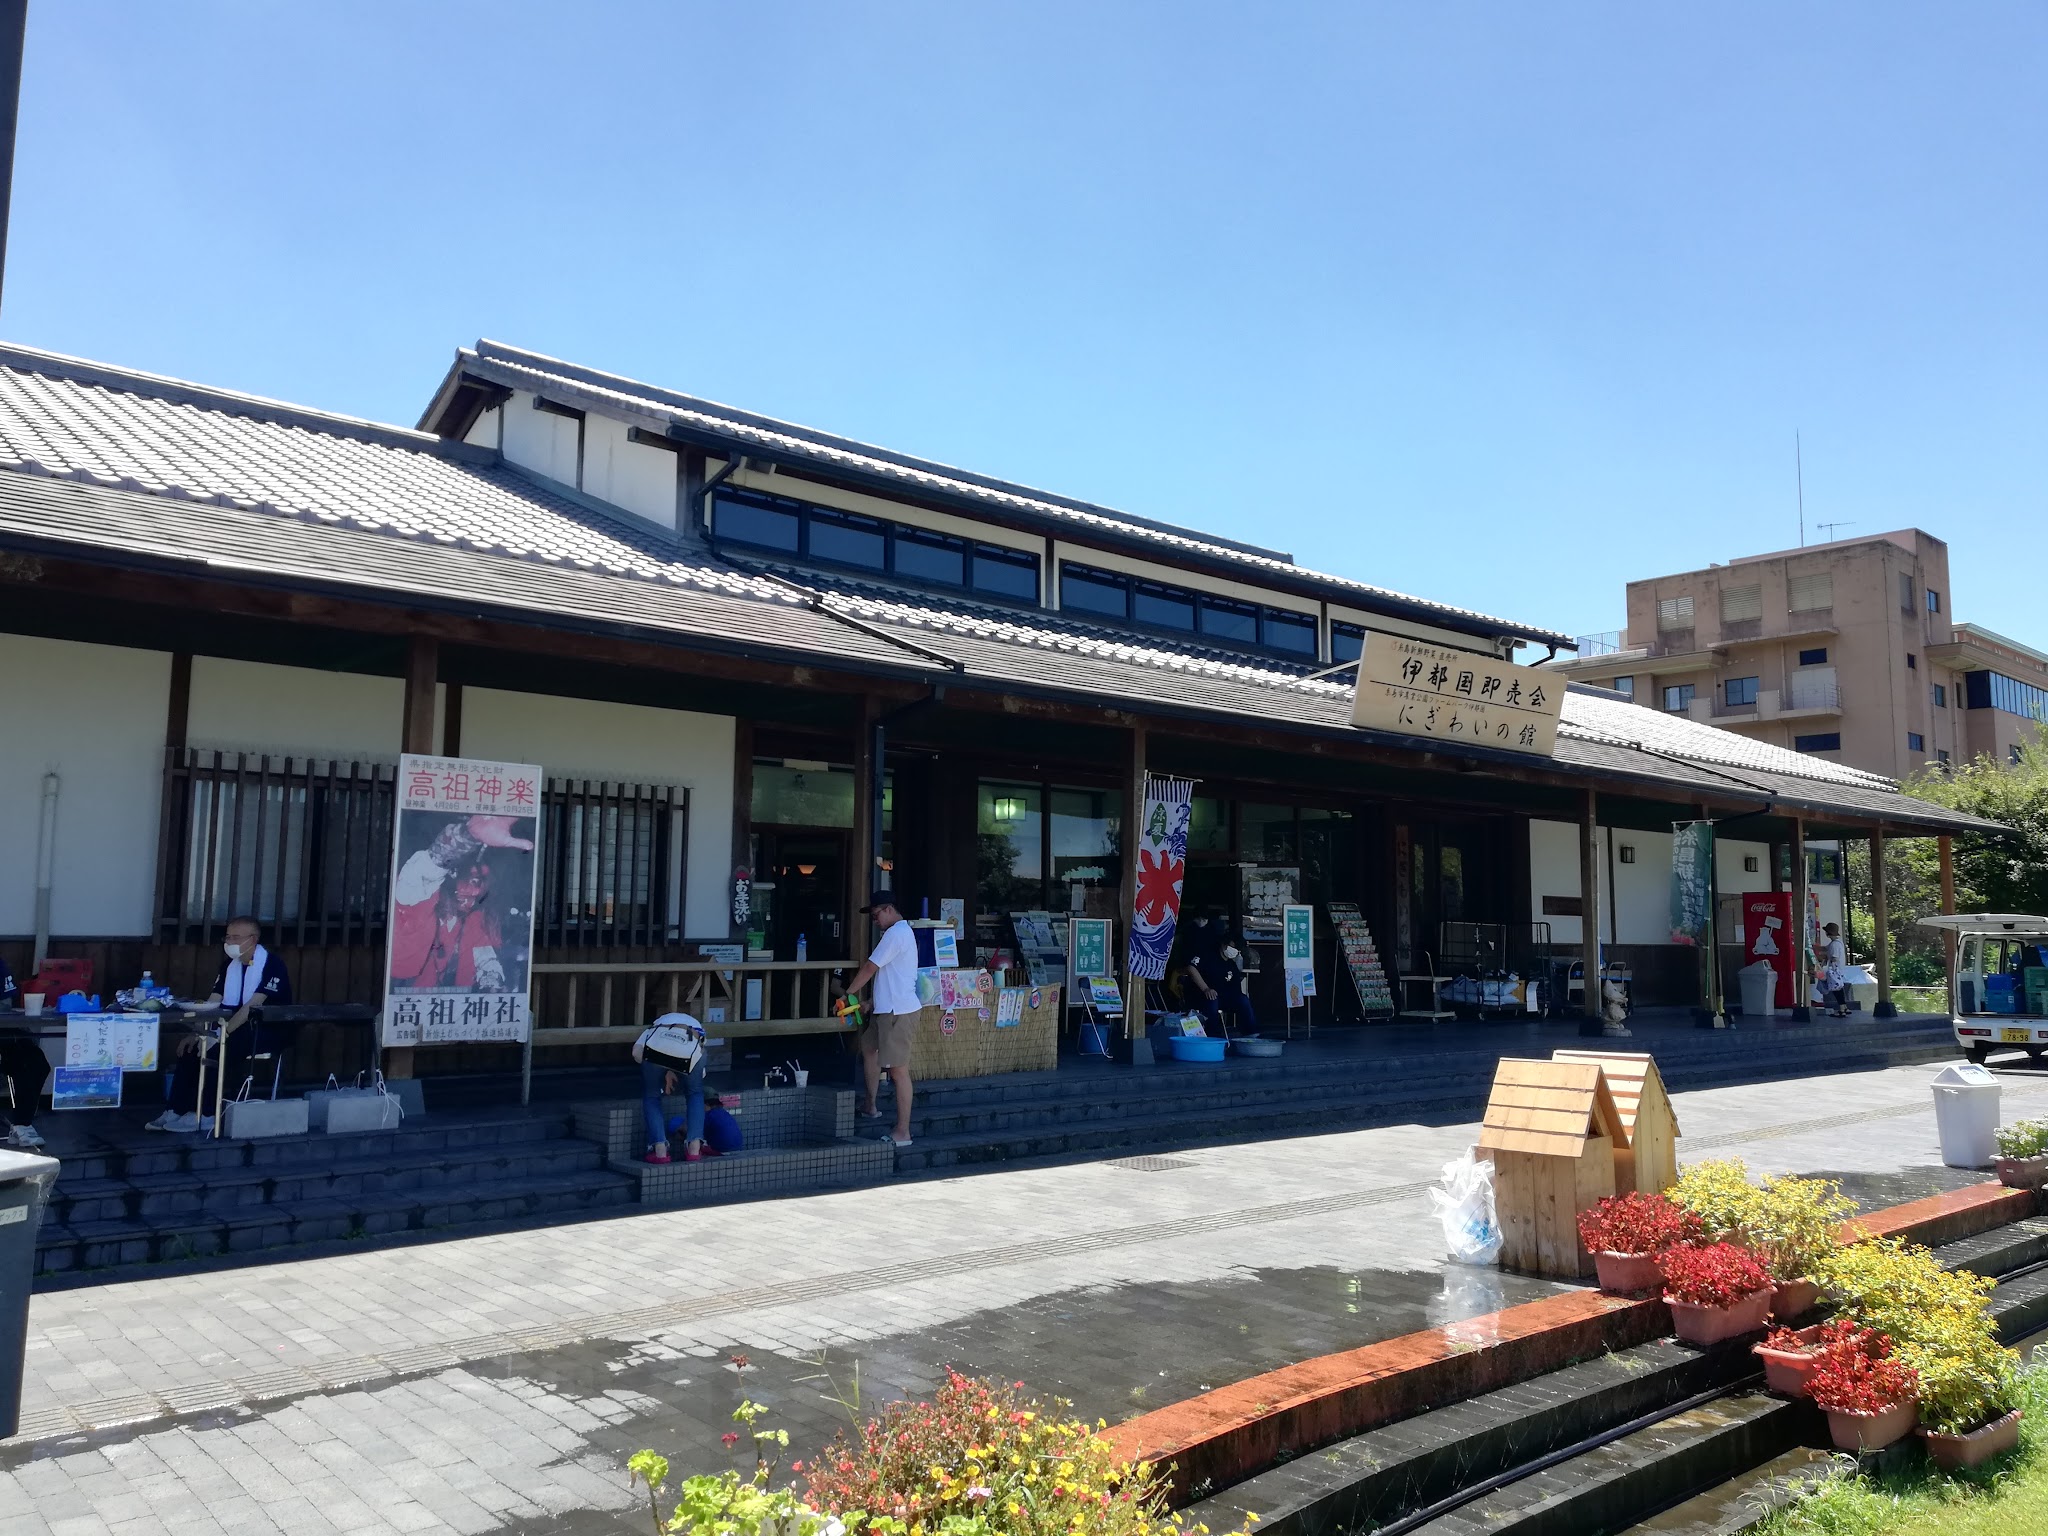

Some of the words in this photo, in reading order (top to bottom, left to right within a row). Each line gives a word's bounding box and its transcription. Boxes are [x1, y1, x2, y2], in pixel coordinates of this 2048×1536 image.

[1402, 656, 1546, 708] 伊都国即売会
[1399, 704, 1538, 746] にぎわいの館
[409, 759, 504, 775] 県指定無形文化財
[408, 769, 534, 805] 高祖神楽
[734, 878, 750, 926] お手洗い
[980, 977, 990, 989] 祭
[393, 996, 521, 1026] 高祖神社
[944, 1018, 954, 1029] 祭
[664, 1033, 686, 1043] COACH
